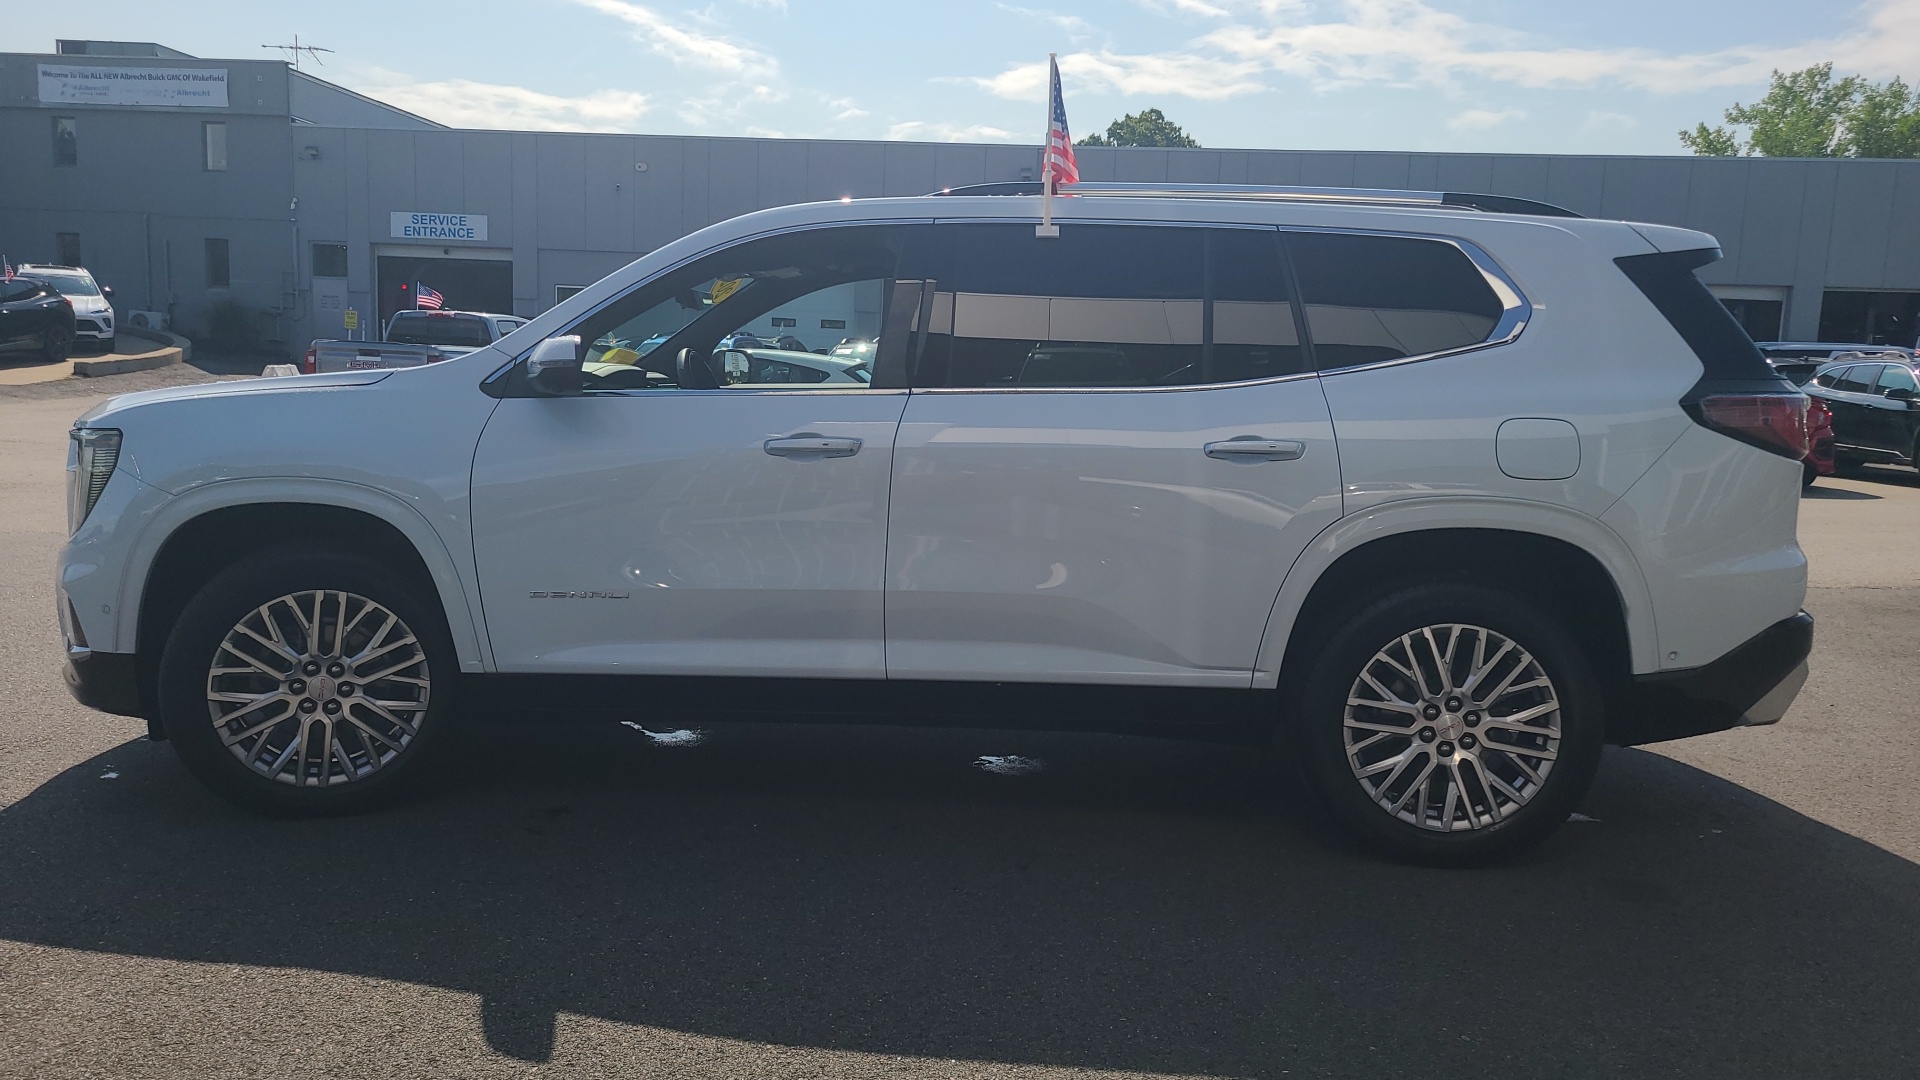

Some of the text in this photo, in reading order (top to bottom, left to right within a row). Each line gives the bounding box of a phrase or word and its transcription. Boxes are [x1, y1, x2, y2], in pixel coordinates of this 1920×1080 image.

[41, 70, 69, 78] Welcome
[103, 72, 119, 80] NEW
[119, 72, 147, 81] Albrecht
[148, 73, 166, 81] Buick
[191, 74, 225, 82] Wakefield
[78, 84, 110, 92] Albrecht
[176, 89, 211, 97] Albrecht
[411, 214, 467, 226] SERVICE
[403, 225, 475, 239] ENTRANCE
[529, 590, 630, 599] DENALI
